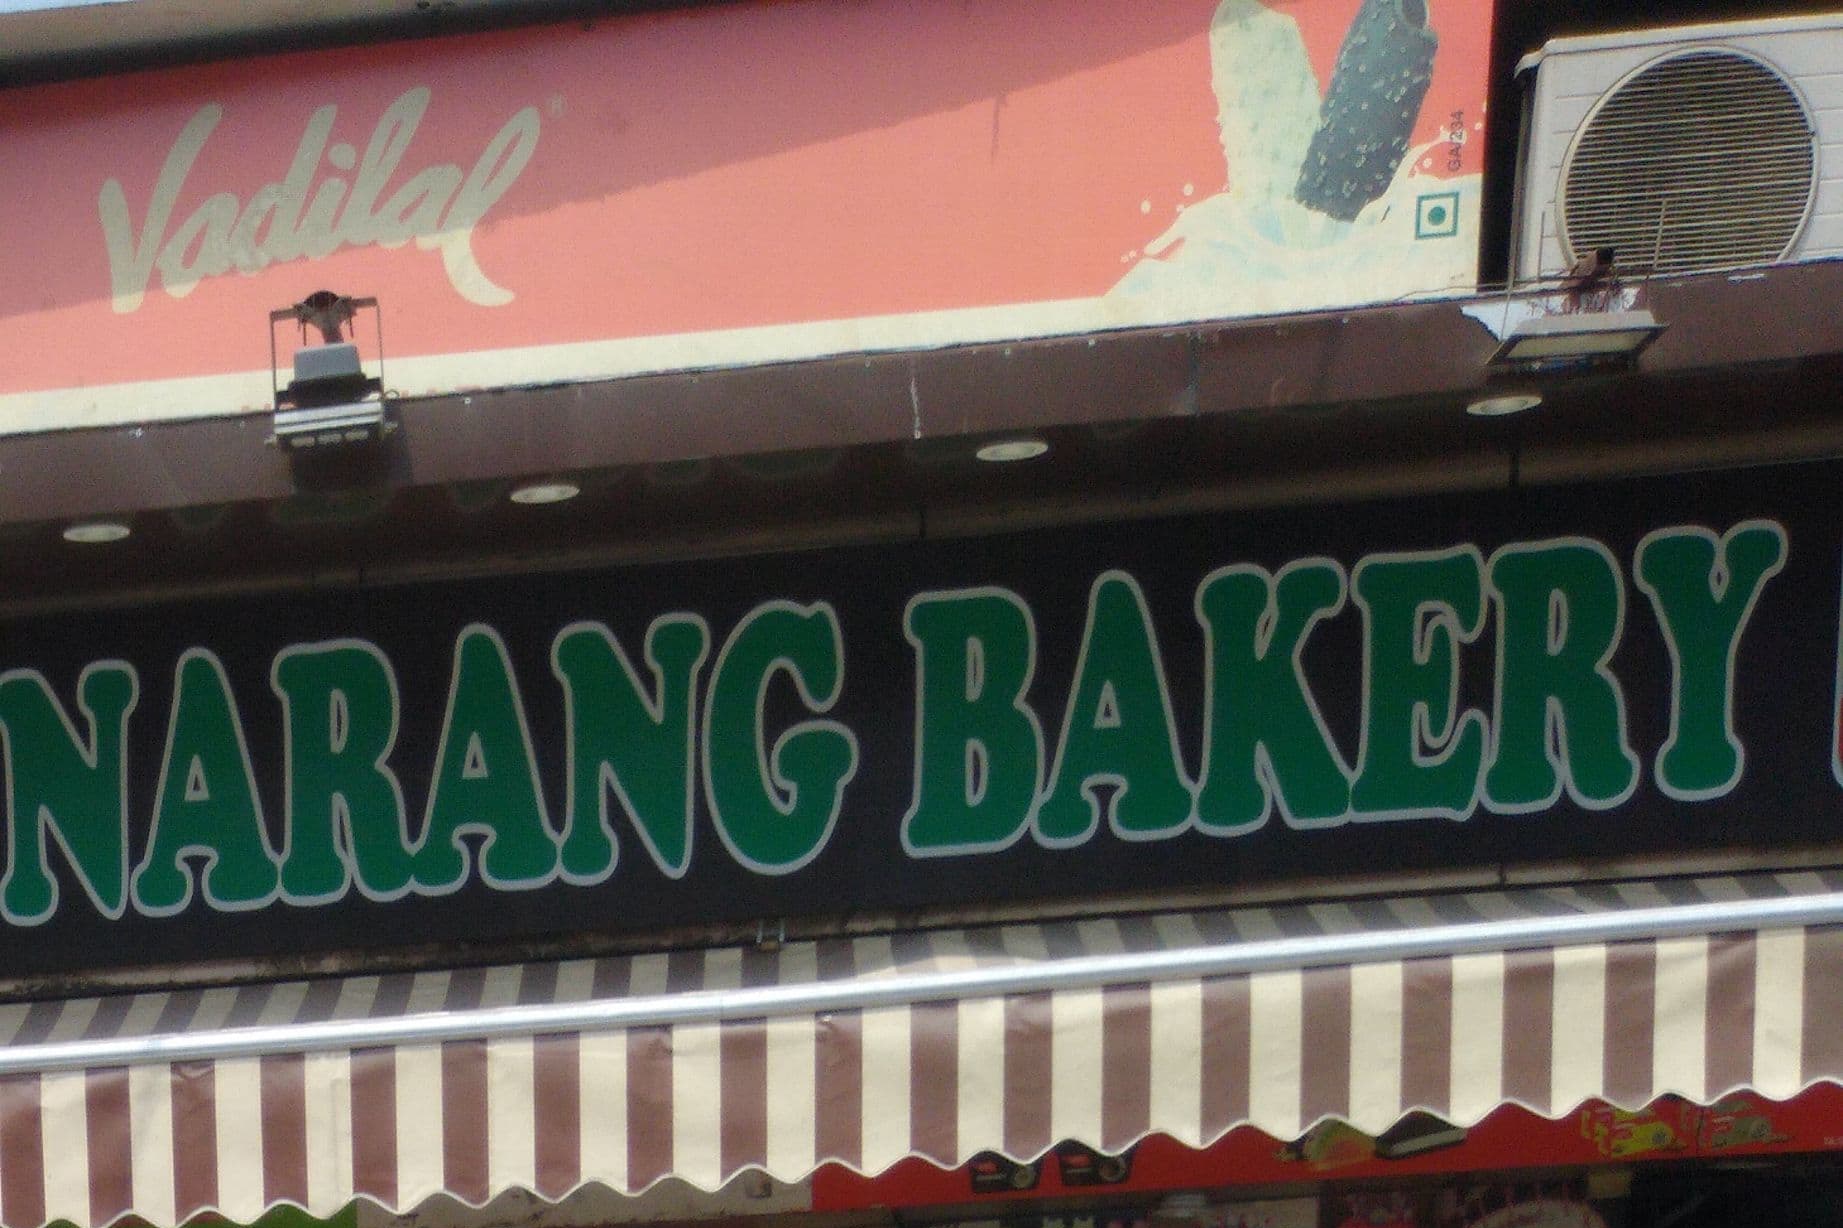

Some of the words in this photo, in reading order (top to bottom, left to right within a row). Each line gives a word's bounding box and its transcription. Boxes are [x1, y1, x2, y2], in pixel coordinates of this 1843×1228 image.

[97, 86, 541, 312] Vadilal
[0, 600, 859, 926] NARANG
[900, 519, 1789, 859] BAKERY
